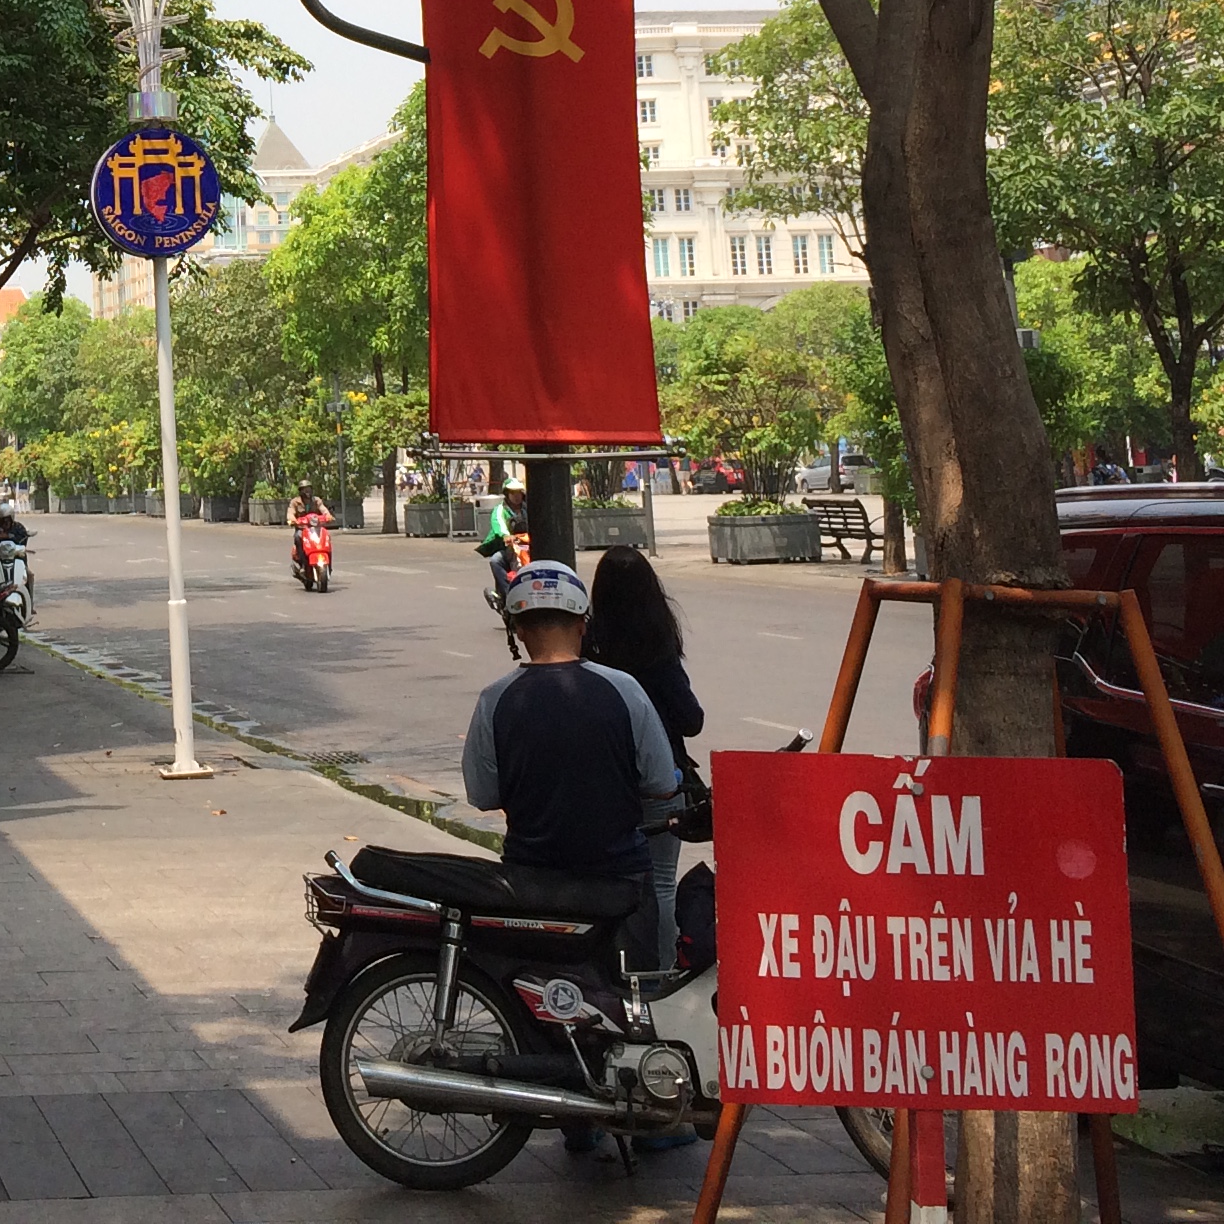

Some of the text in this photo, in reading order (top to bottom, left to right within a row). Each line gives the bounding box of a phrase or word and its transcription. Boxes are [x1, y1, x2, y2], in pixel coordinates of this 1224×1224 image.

[102, 202, 217, 248] SAIGON PENINSULA
[838, 759, 985, 876] CẤM
[504, 920, 545, 930] HONDA
[758, 891, 1095, 997] XE ĐẬU TRÊN VỈA HÈ
[720, 1005, 1135, 1101] VÀ BUÔN BÁN HÀNG RONG
